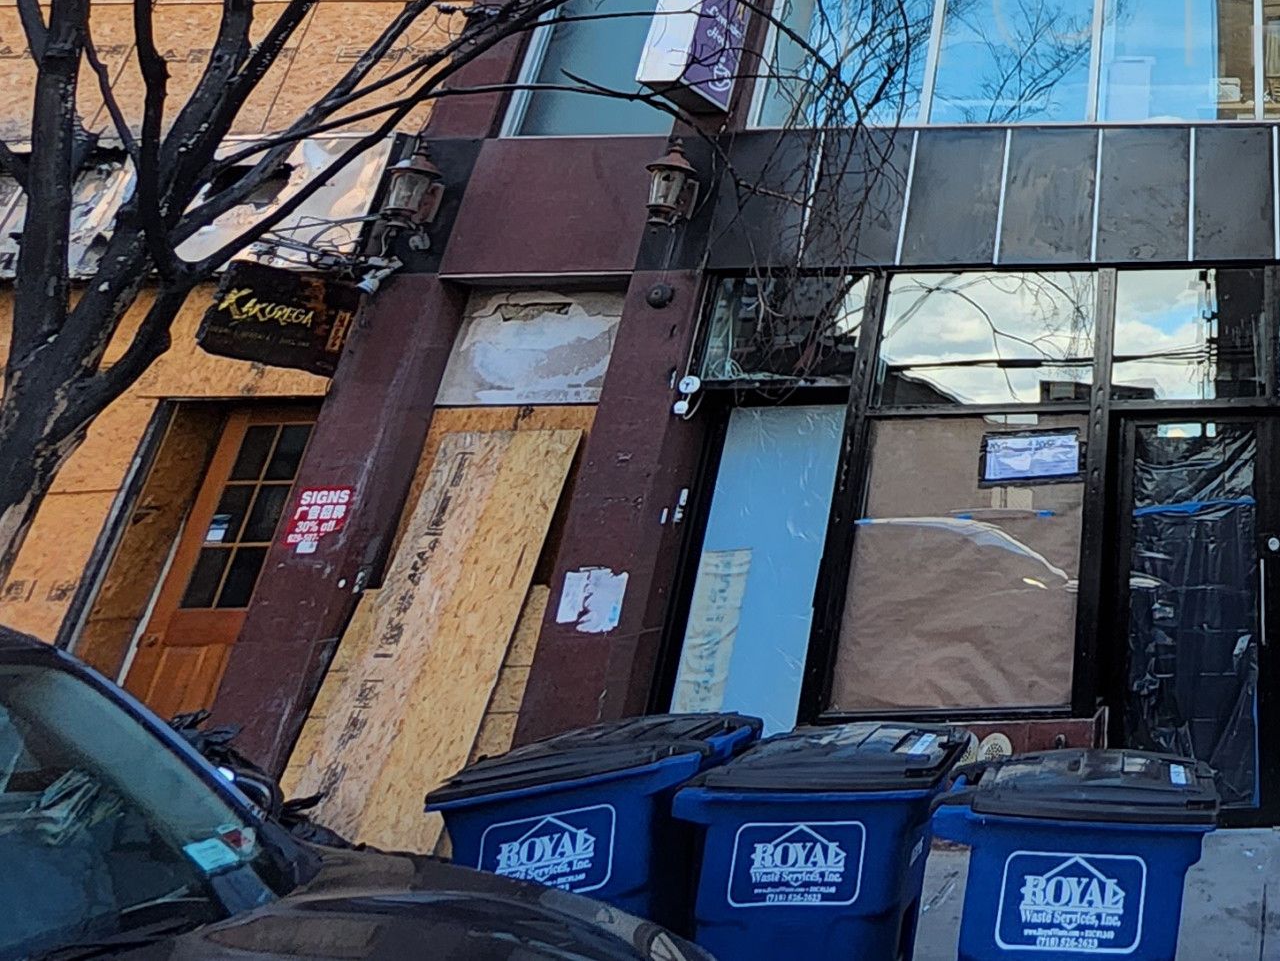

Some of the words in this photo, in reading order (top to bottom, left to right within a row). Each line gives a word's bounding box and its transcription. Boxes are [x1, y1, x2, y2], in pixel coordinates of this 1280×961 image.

[301, 490, 350, 505] SIGNS
[295, 521, 319, 532] 30%
[496, 828, 596, 869] ROYAL
[751, 842, 846, 869] ROYAL
[752, 870, 780, 884] Waste
[824, 869, 842, 882] Inc.
[1021, 875, 1123, 910] ROYAL
[1021, 909, 1052, 924] Waste
[1101, 913, 1121, 927] Inc.
